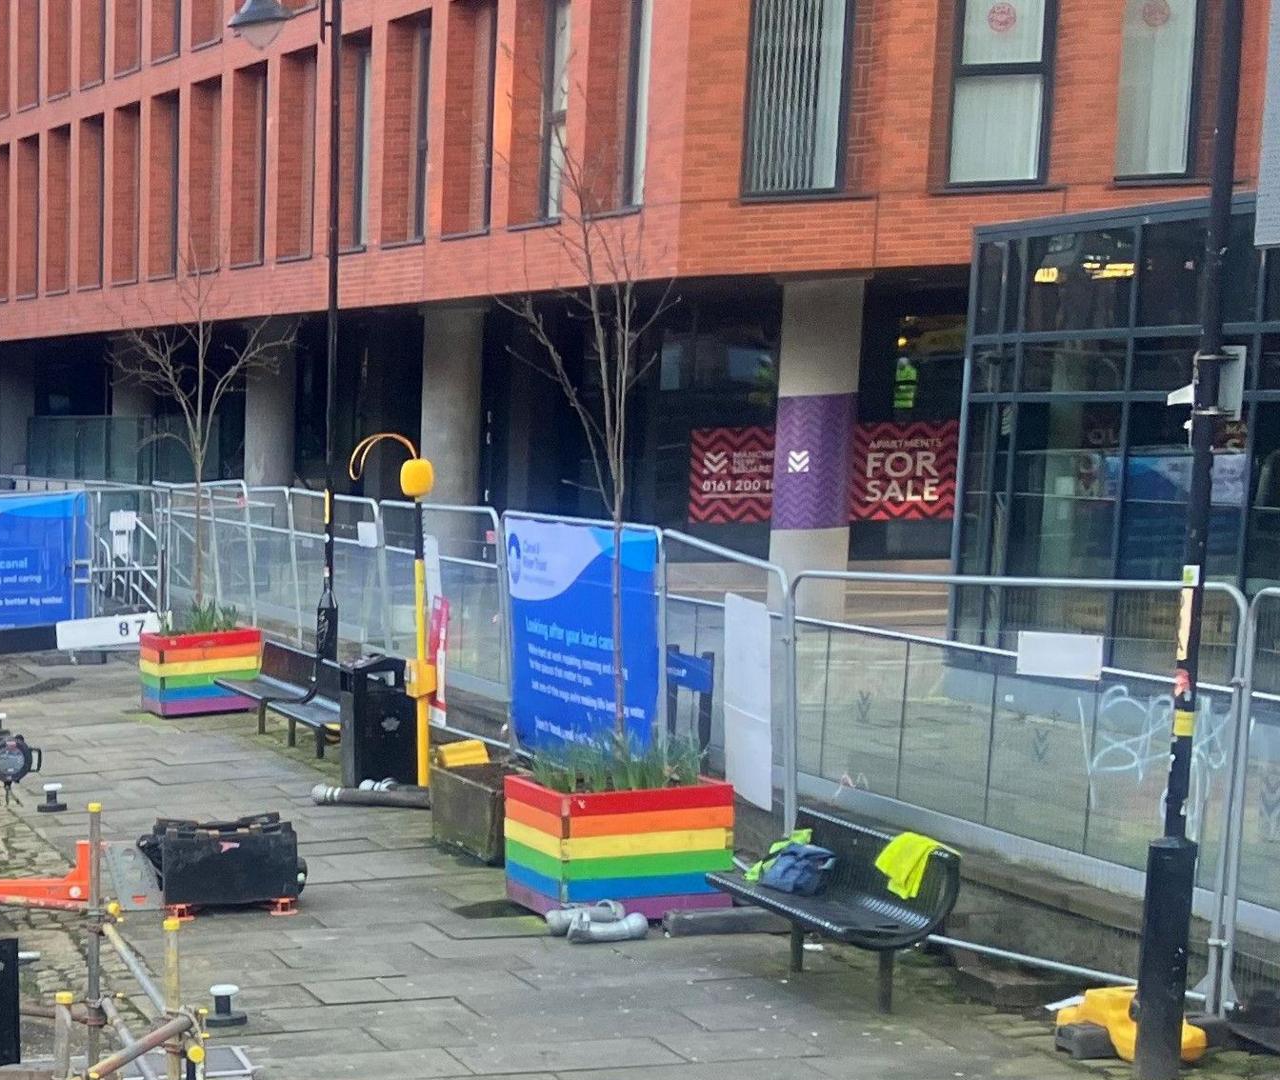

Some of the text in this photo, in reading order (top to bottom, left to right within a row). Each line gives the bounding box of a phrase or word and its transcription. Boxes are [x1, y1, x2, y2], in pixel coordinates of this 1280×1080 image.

[868, 438, 943, 448] APARTMENTS
[866, 450, 939, 478] FOR
[702, 480, 732, 492] 0161
[735, 480, 760, 491] 200
[865, 478, 941, 502] SALE
[0, 557, 28, 569] canal
[119, 619, 146, 636] 87
